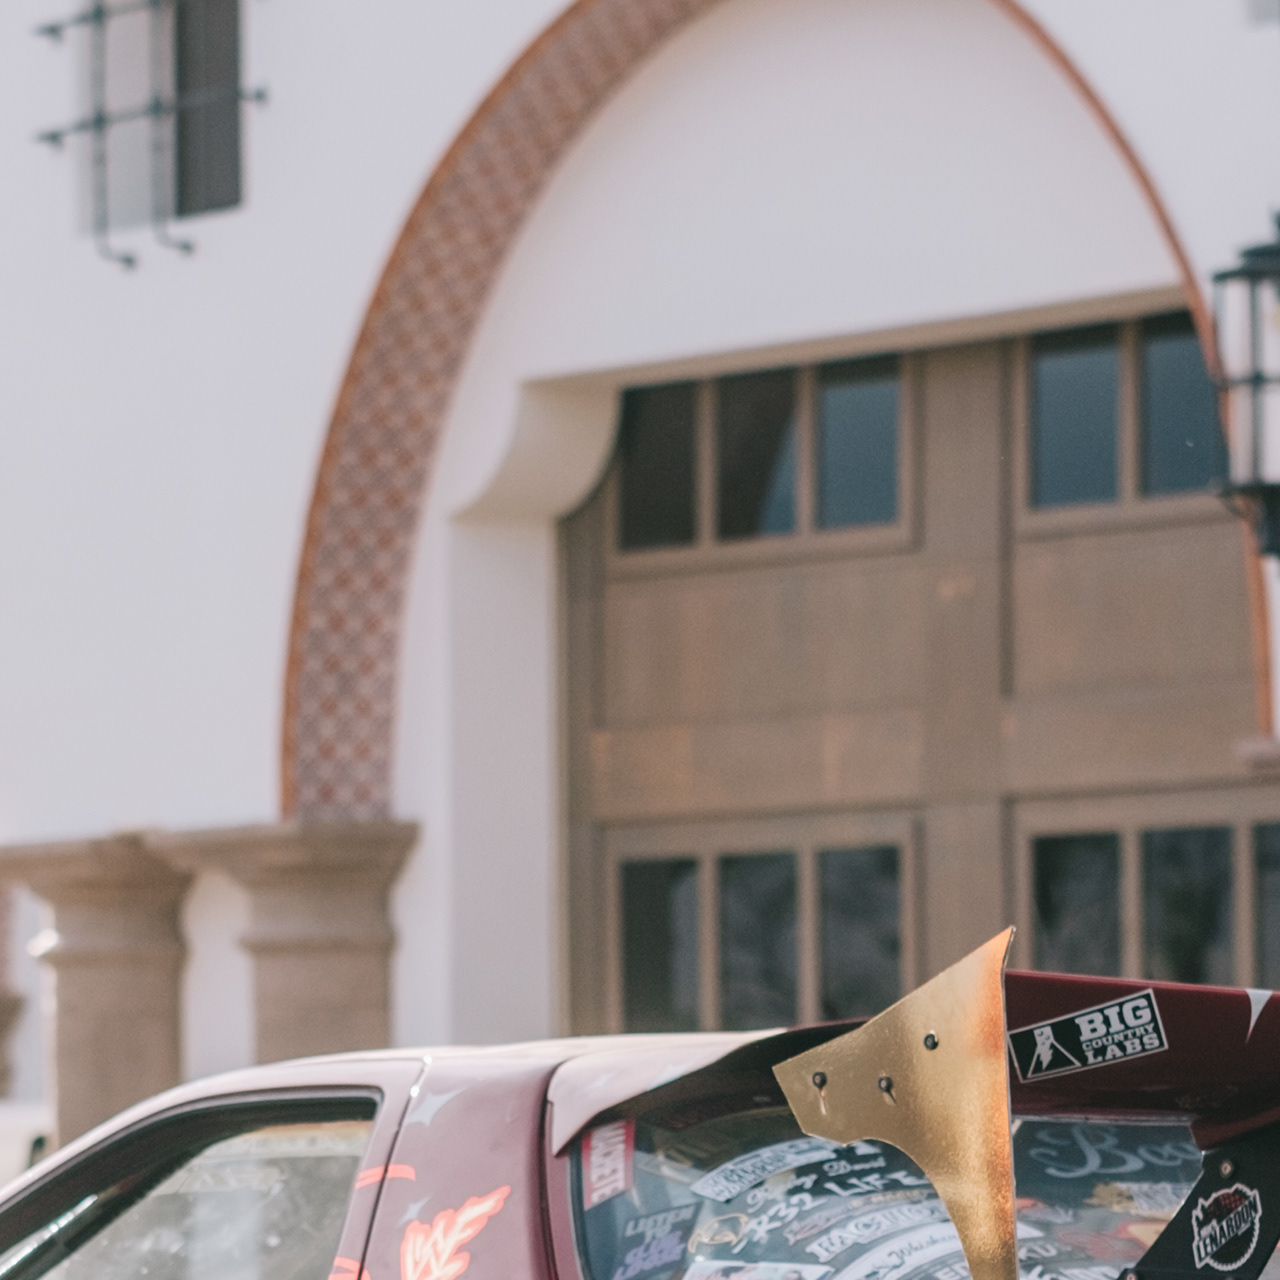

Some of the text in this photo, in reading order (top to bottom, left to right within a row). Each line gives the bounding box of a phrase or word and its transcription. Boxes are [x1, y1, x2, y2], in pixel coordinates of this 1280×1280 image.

[1074, 997, 1152, 1042] BIG
[1082, 1023, 1155, 1050] COUNTRY
[1084, 1033, 1160, 1065] LABS
